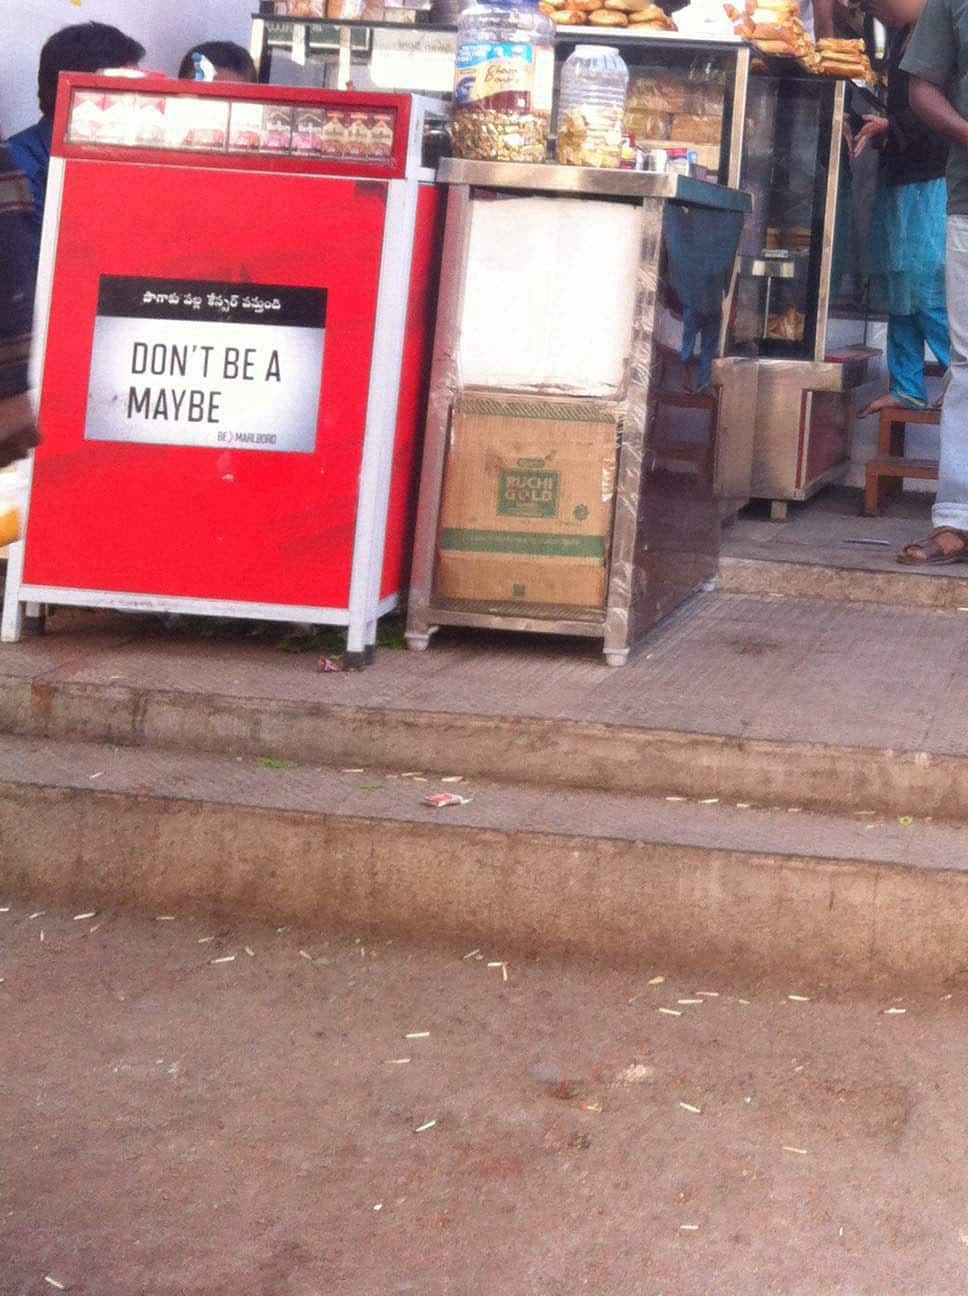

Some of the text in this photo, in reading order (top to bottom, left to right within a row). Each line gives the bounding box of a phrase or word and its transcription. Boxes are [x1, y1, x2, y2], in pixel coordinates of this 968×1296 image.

[131, 341, 281, 383] DON'T BE A
[127, 386, 222, 423] MAYBE
[235, 432, 277, 445] MARLBORO
[504, 489, 553, 503] GOLD
